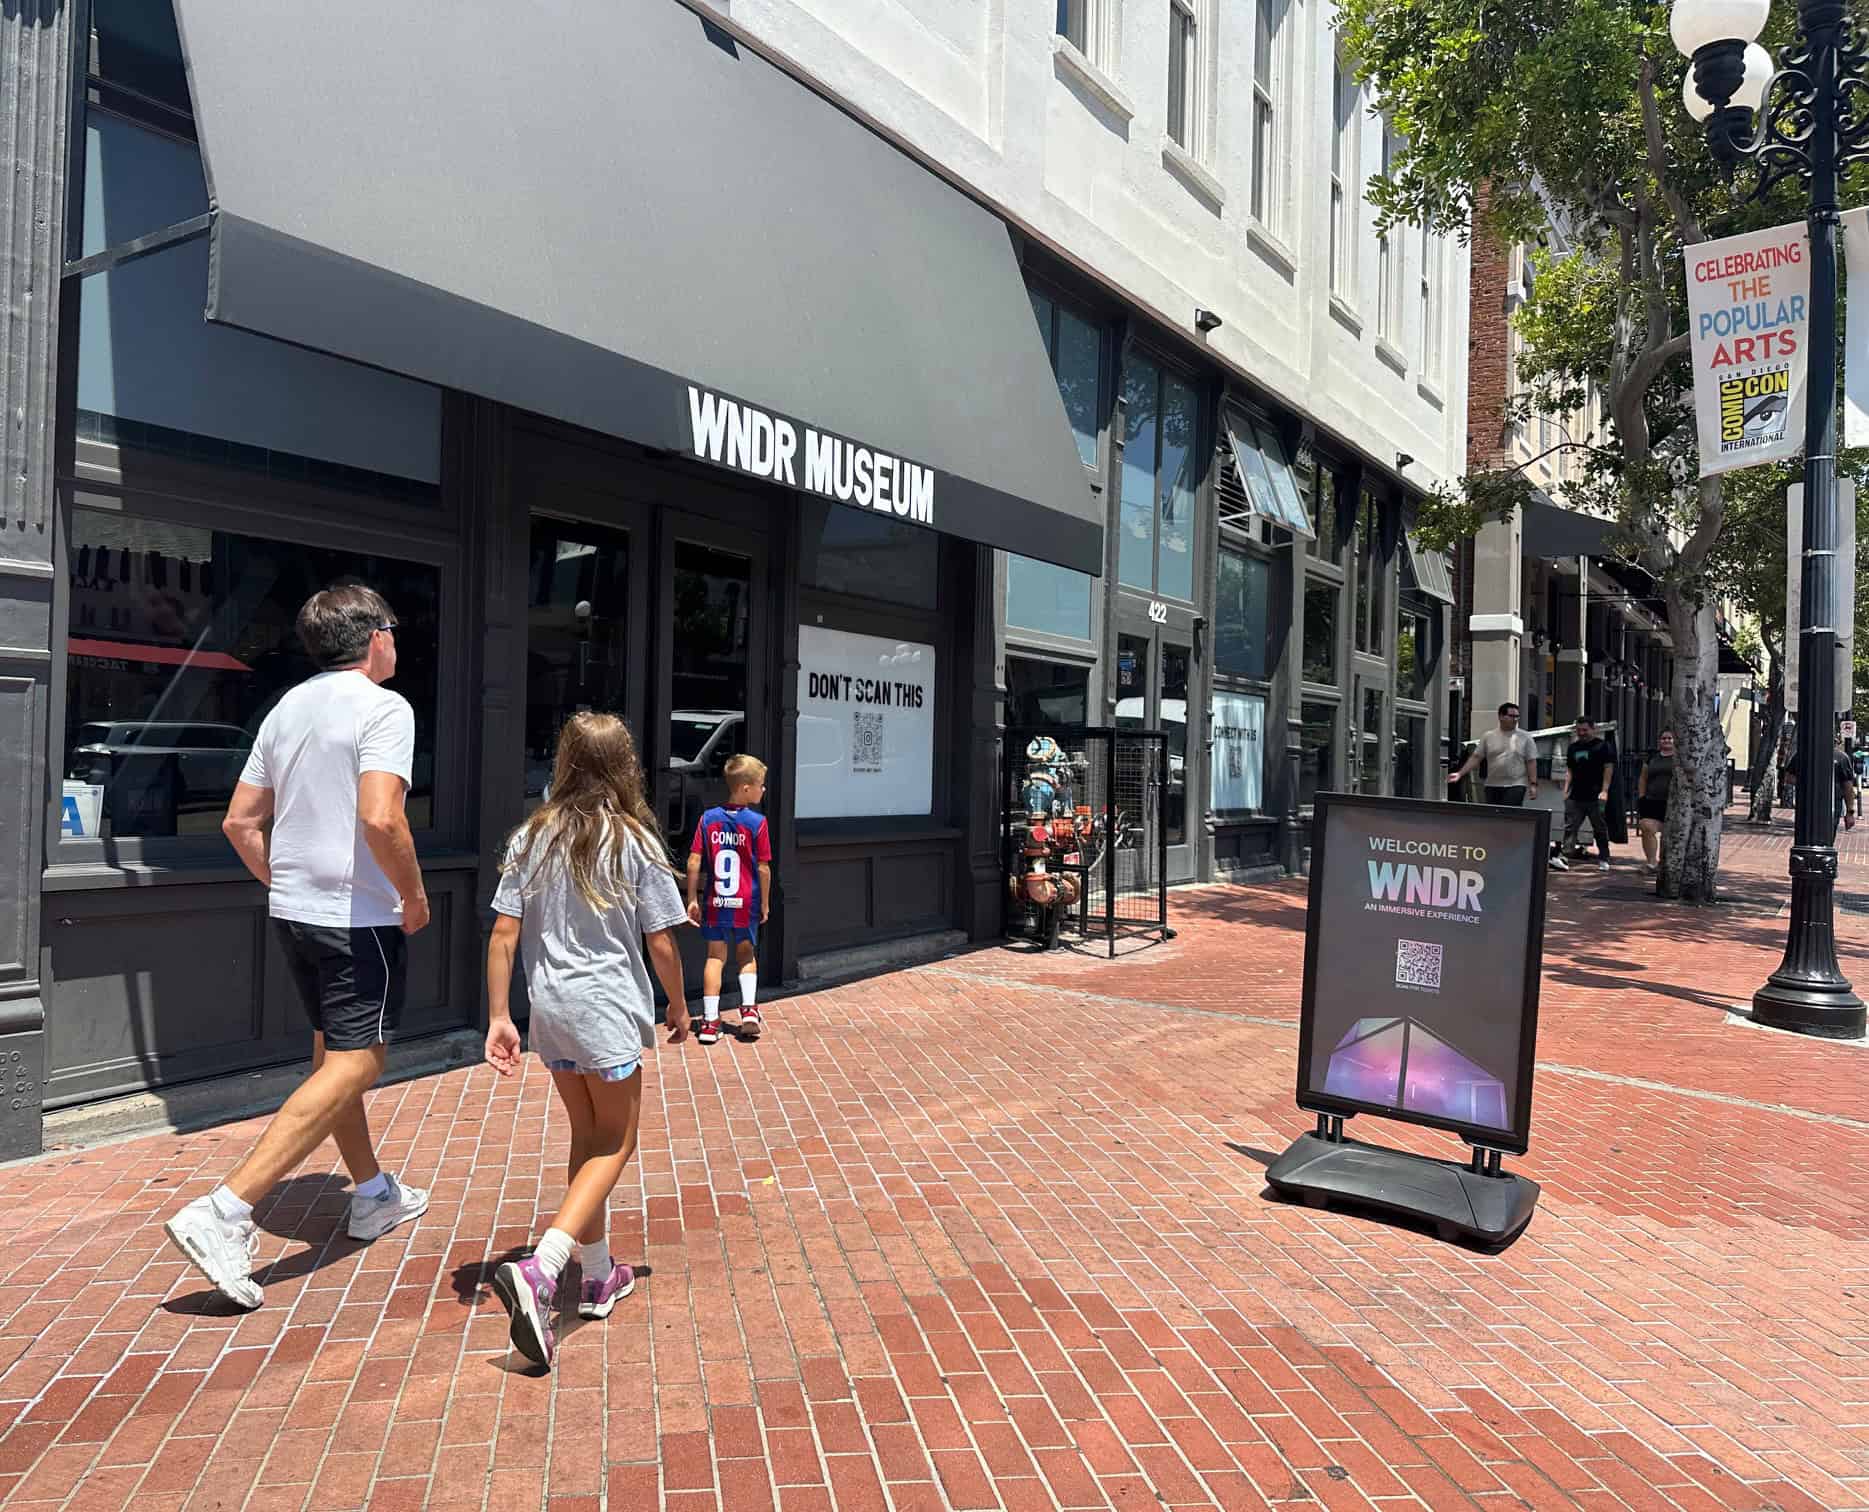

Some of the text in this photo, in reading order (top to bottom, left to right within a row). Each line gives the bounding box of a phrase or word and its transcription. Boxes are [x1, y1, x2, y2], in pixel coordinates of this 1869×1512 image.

[1695, 242, 1801, 283] CELEBRATING
[1728, 275, 1771, 302] THE
[1700, 295, 1805, 340] POPULAR
[1711, 329, 1797, 369] ARTS
[1744, 371, 1789, 398] CON
[1721, 380, 1744, 441] COMIC
[688, 386, 934, 524] WNDR MUSEUM
[1721, 431, 1785, 453] INTERNATIONAL
[1148, 601, 1167, 623] 422
[808, 672, 923, 709] DON'T SCAN THIS
[711, 831, 746, 847] CONOR
[1369, 836, 1487, 862] WELCOME TO
[714, 849, 741, 897] 9
[1367, 860, 1485, 912] WNDR
[1364, 902, 1481, 924] AN IMMERSIVE EXPERIENCE
